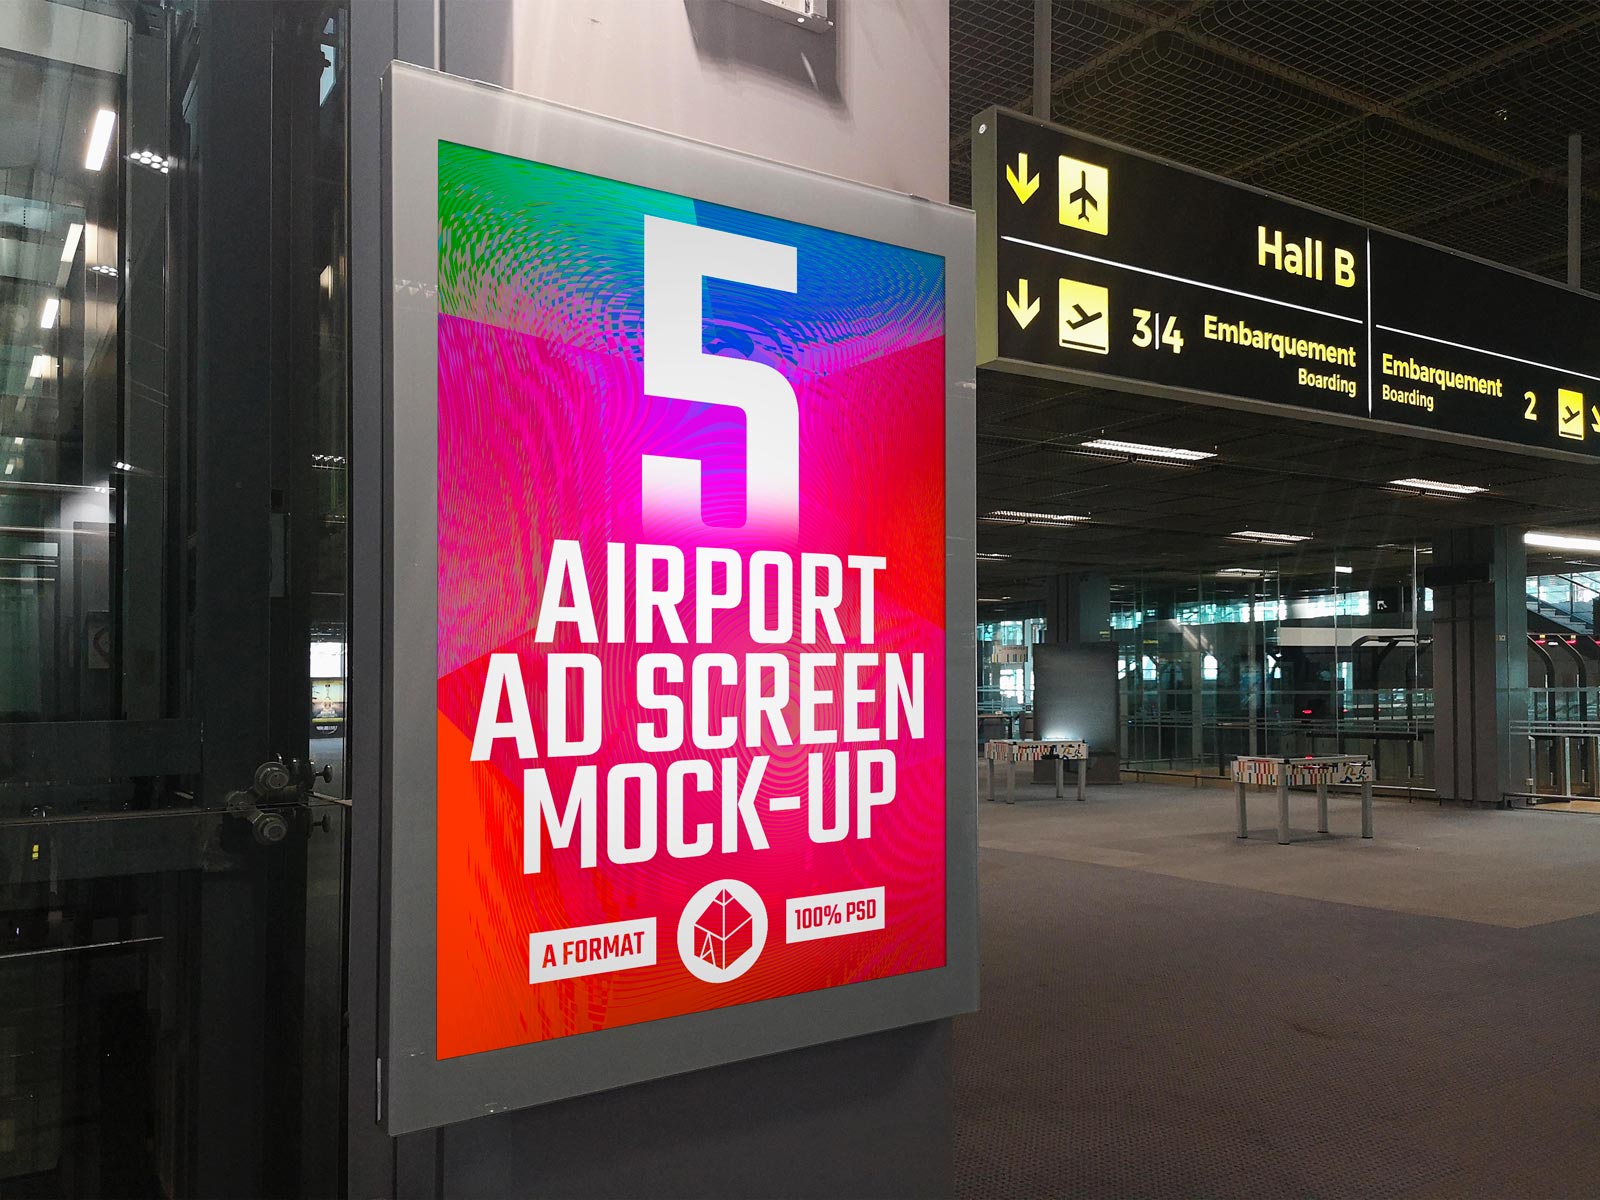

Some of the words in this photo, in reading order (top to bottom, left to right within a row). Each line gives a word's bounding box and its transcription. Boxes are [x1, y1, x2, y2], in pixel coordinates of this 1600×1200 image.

[1257, 226, 1323, 281] Hall
[1334, 247, 1356, 288] B
[1204, 315, 1357, 368] Embarquement
[642, 214, 799, 541] 5
[1298, 367, 1357, 398] Boarding
[1382, 353, 1503, 398] Embarquement
[1523, 391, 1538, 421] 2
[1382, 384, 1434, 412] Boarding
[535, 539, 887, 645] AIRPORT
[470, 653, 603, 762] AD
[636, 652, 925, 753] SCREEN
[523, 749, 897, 875] MOCK-UP
[794, 903, 842, 930] 100%
[846, 899, 877, 923] PSD
[541, 944, 557, 969] A
[562, 931, 645, 966] FORMAT
